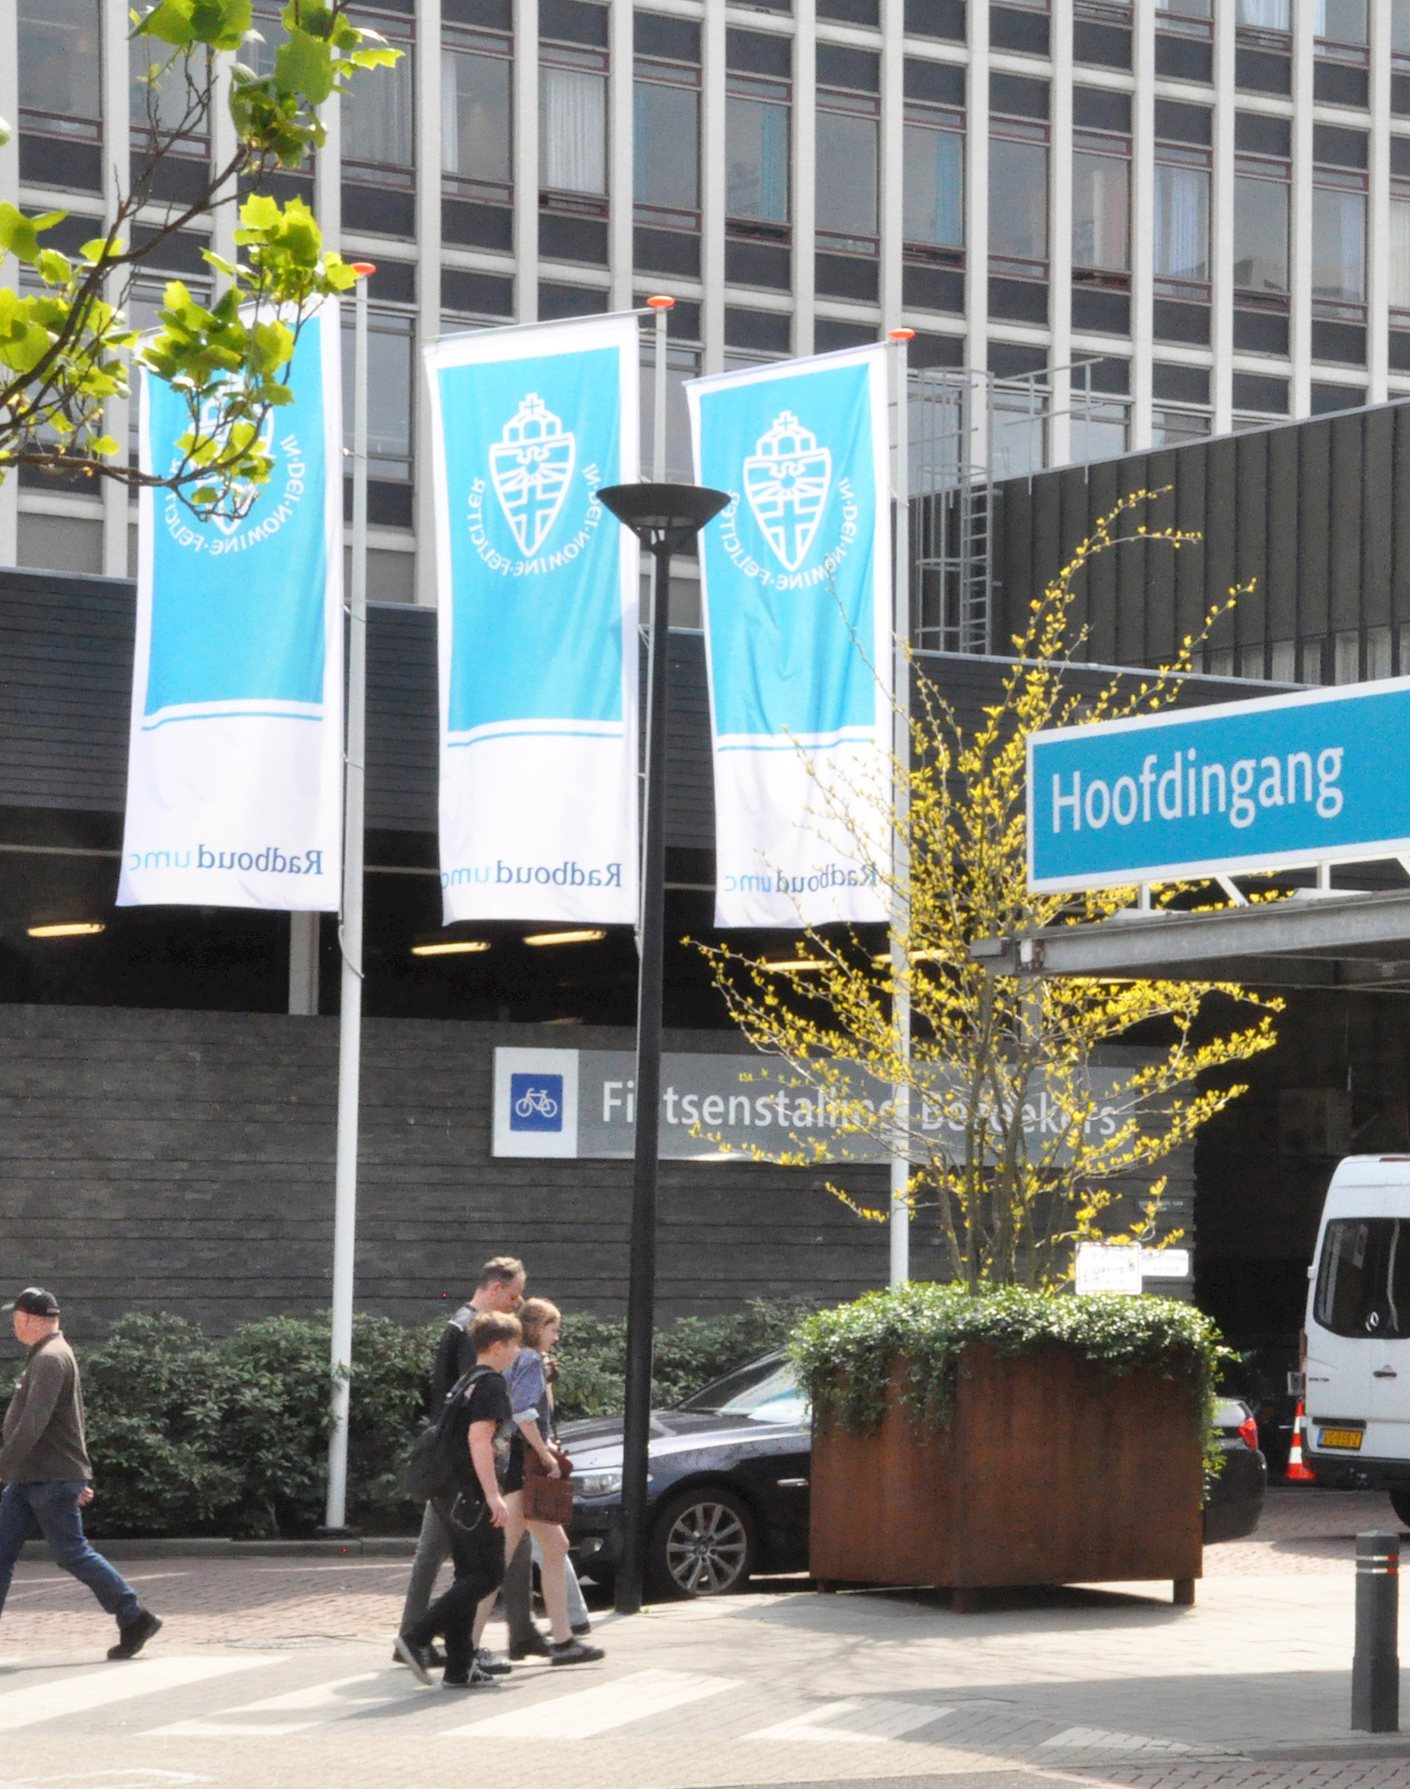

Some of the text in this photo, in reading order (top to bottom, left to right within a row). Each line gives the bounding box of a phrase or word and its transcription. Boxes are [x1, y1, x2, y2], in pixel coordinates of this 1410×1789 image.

[1052, 747, 1344, 833] Hoofdingang
[602, 1080, 1117, 1137] Fitsenstalli Beoekrs
